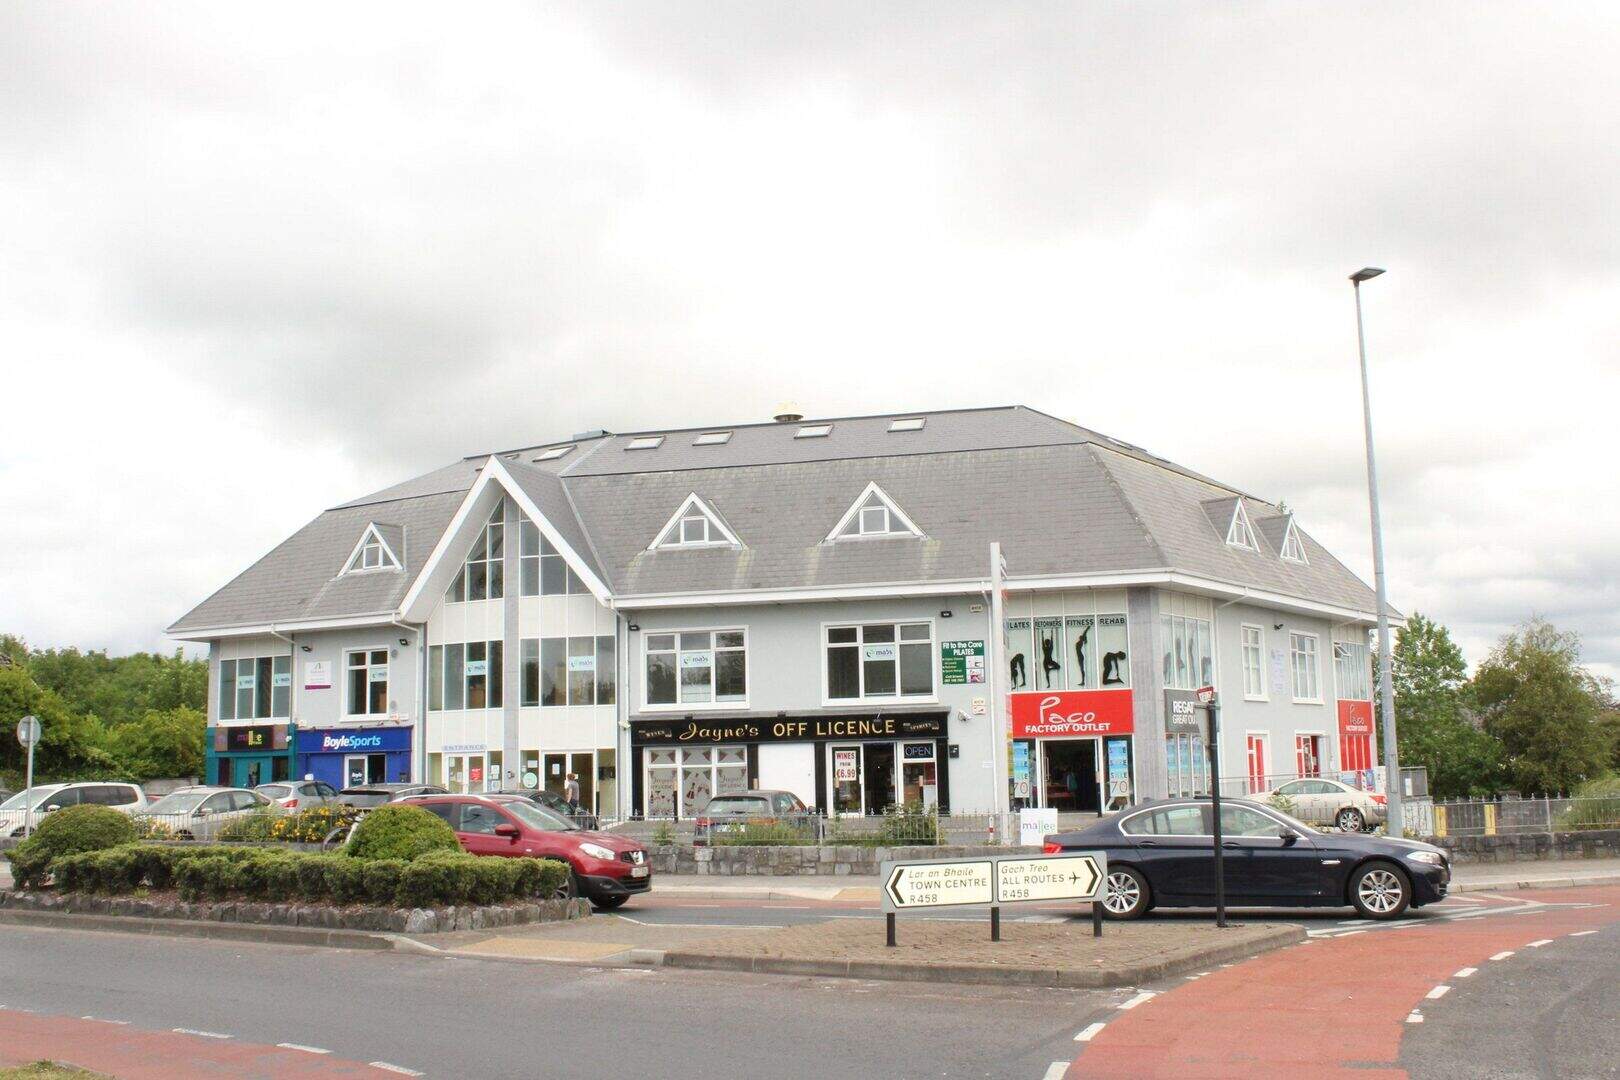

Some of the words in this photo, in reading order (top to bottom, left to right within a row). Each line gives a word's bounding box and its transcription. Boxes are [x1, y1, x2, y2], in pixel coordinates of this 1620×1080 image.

[1008, 621, 1030, 629] LATES
[1099, 617, 1125, 625] REHAB
[953, 648, 975, 656] PILATES
[1040, 696, 1095, 724] Paco
[679, 722, 759, 741] Jayne's
[773, 722, 808, 737] OFF
[816, 719, 896, 735] LICENCE
[1025, 724, 1070, 733] FACTORY
[1072, 722, 1111, 732] OUTLET
[323, 734, 382, 750] BoyleSports
[836, 752, 855, 760] WINES
[905, 746, 932, 756] OPEN
[1110, 780, 1128, 794] 70
[928, 870, 940, 878] an
[944, 867, 974, 877] Bhaile
[1001, 864, 1025, 874] Gach
[1029, 864, 1049, 872] Treo
[910, 880, 941, 890] TOWN
[945, 877, 988, 889] CENTRE
[1002, 876, 1021, 885] ALL
[1024, 873, 1065, 884] ROUTES
[909, 893, 938, 903] R458
[1002, 888, 1030, 899] R458
